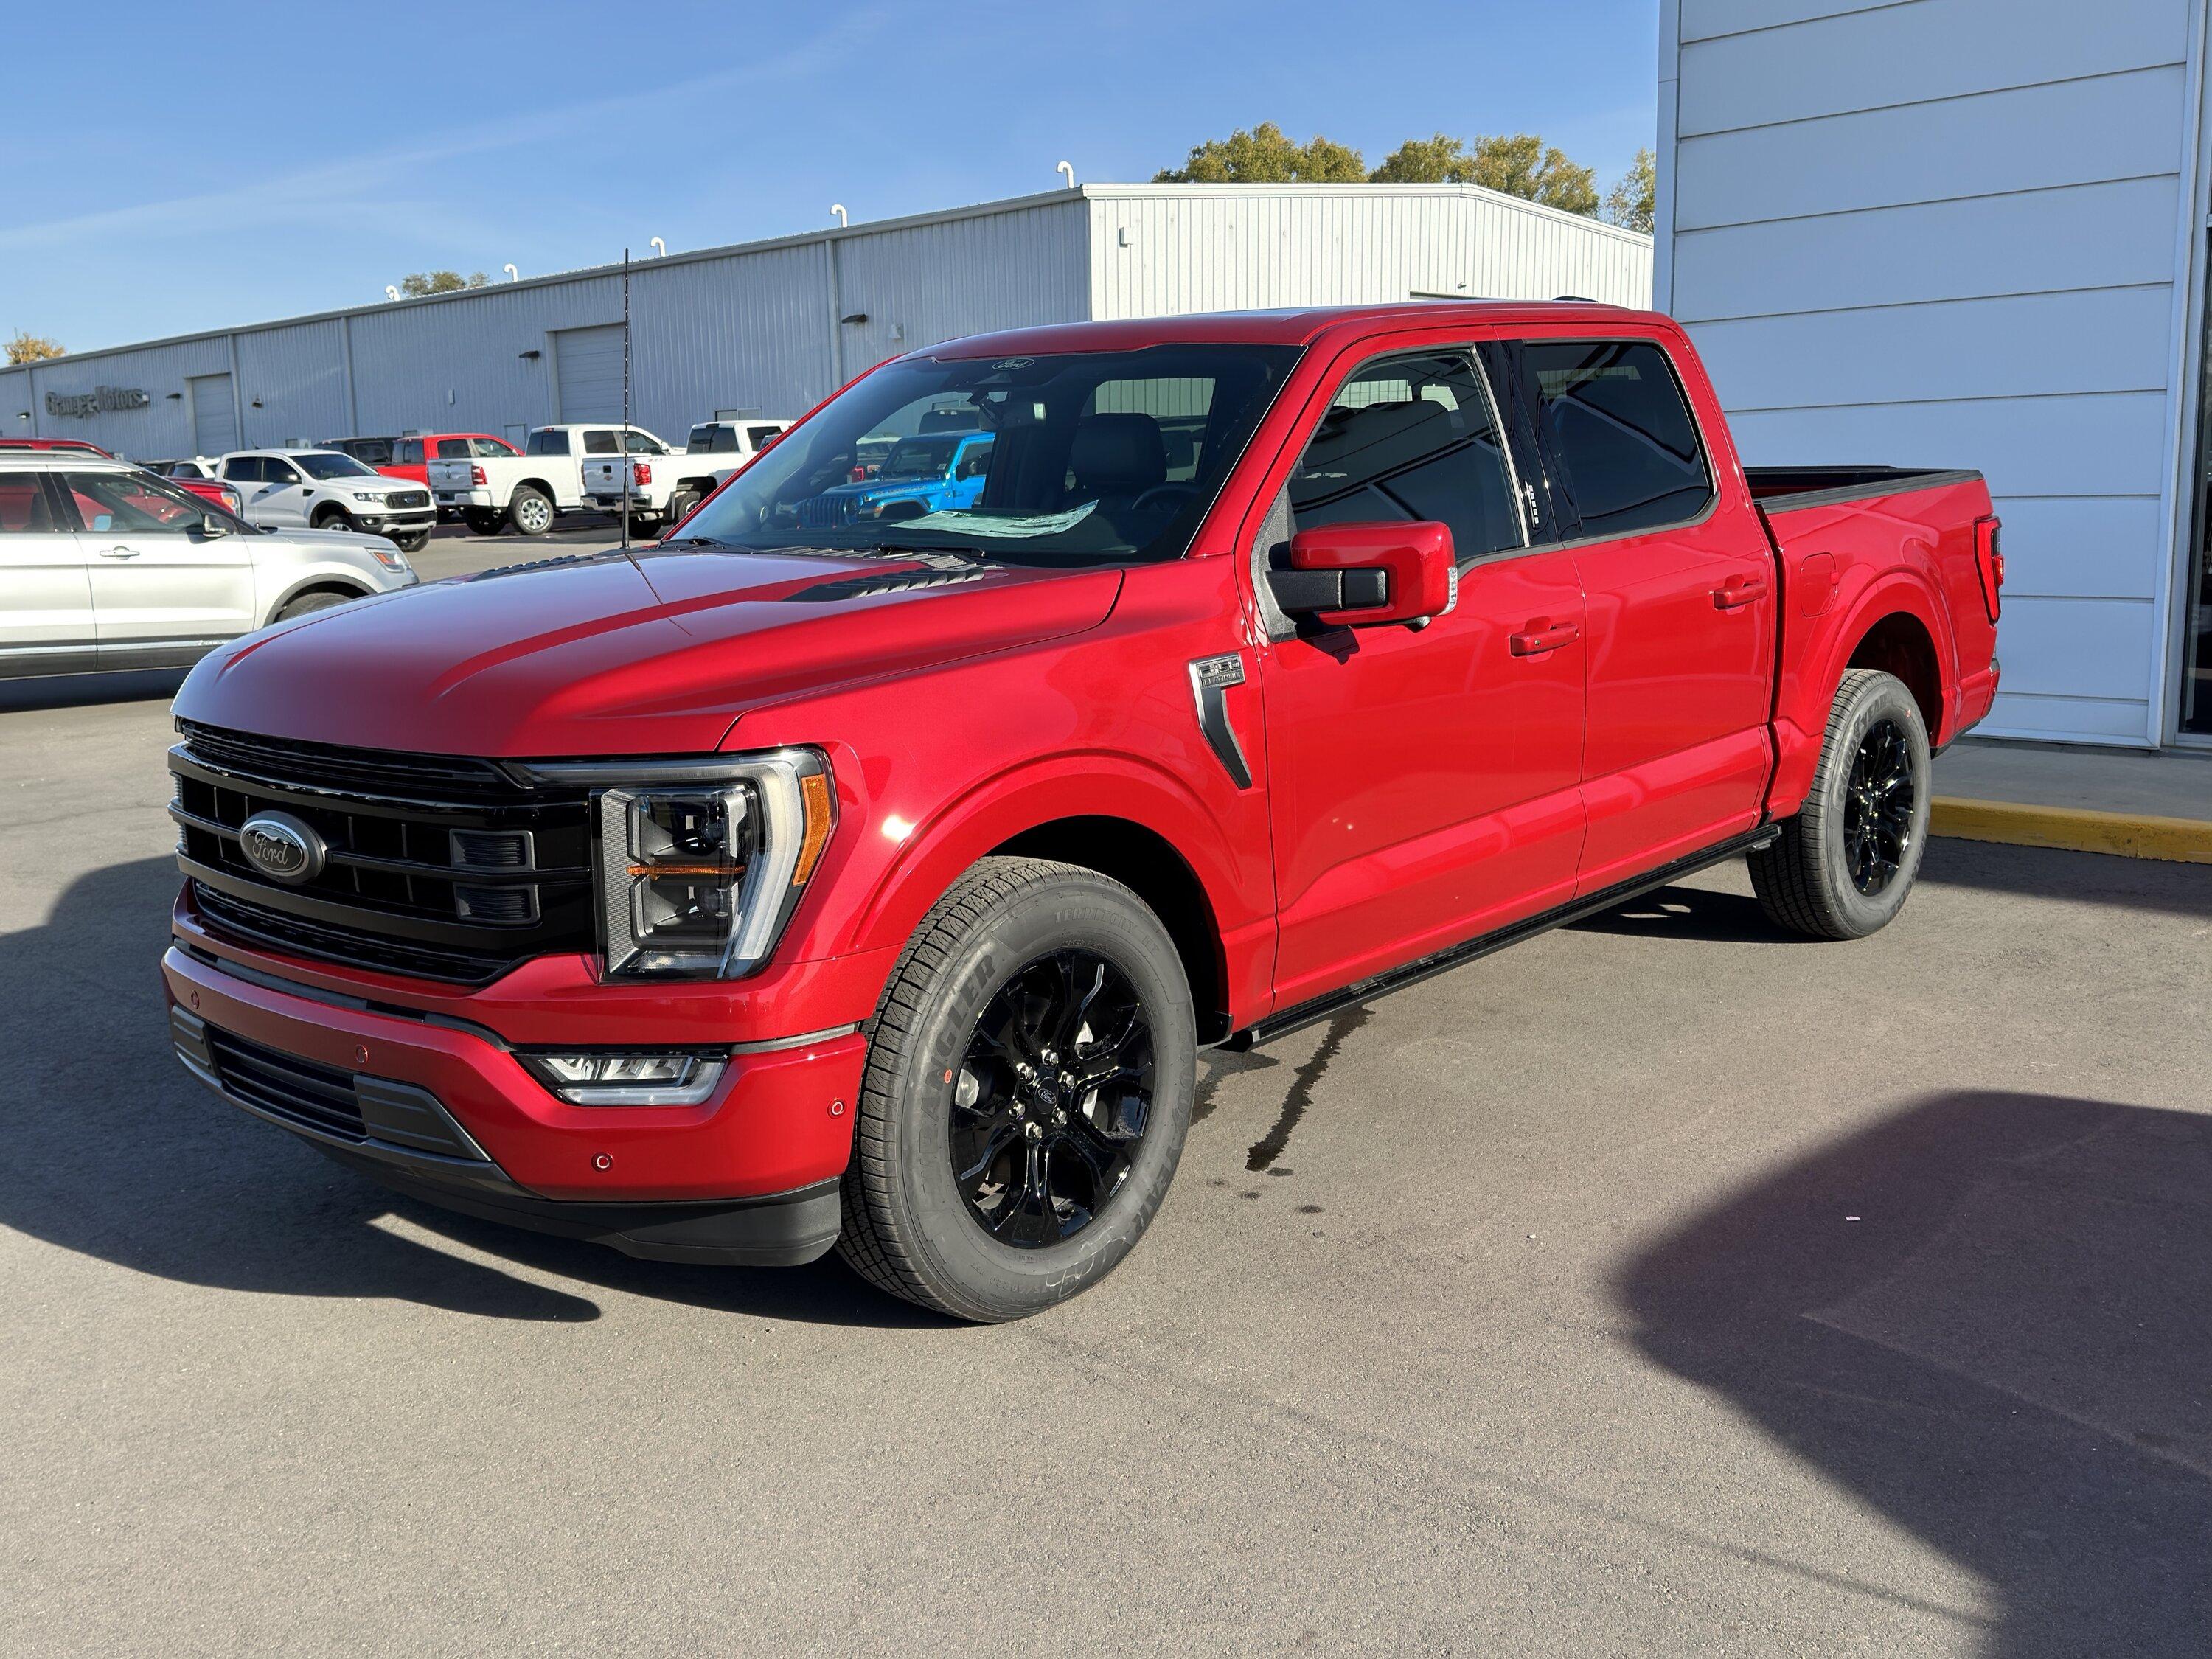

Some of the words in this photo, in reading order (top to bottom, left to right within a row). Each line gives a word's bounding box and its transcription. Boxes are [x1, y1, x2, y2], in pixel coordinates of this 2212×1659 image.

[998, 358, 1029, 369] Ford
[252, 831, 288, 866] Ford
[1055, 907, 1138, 933] TERRITORY
[1040, 1090, 1054, 1102] Ford
